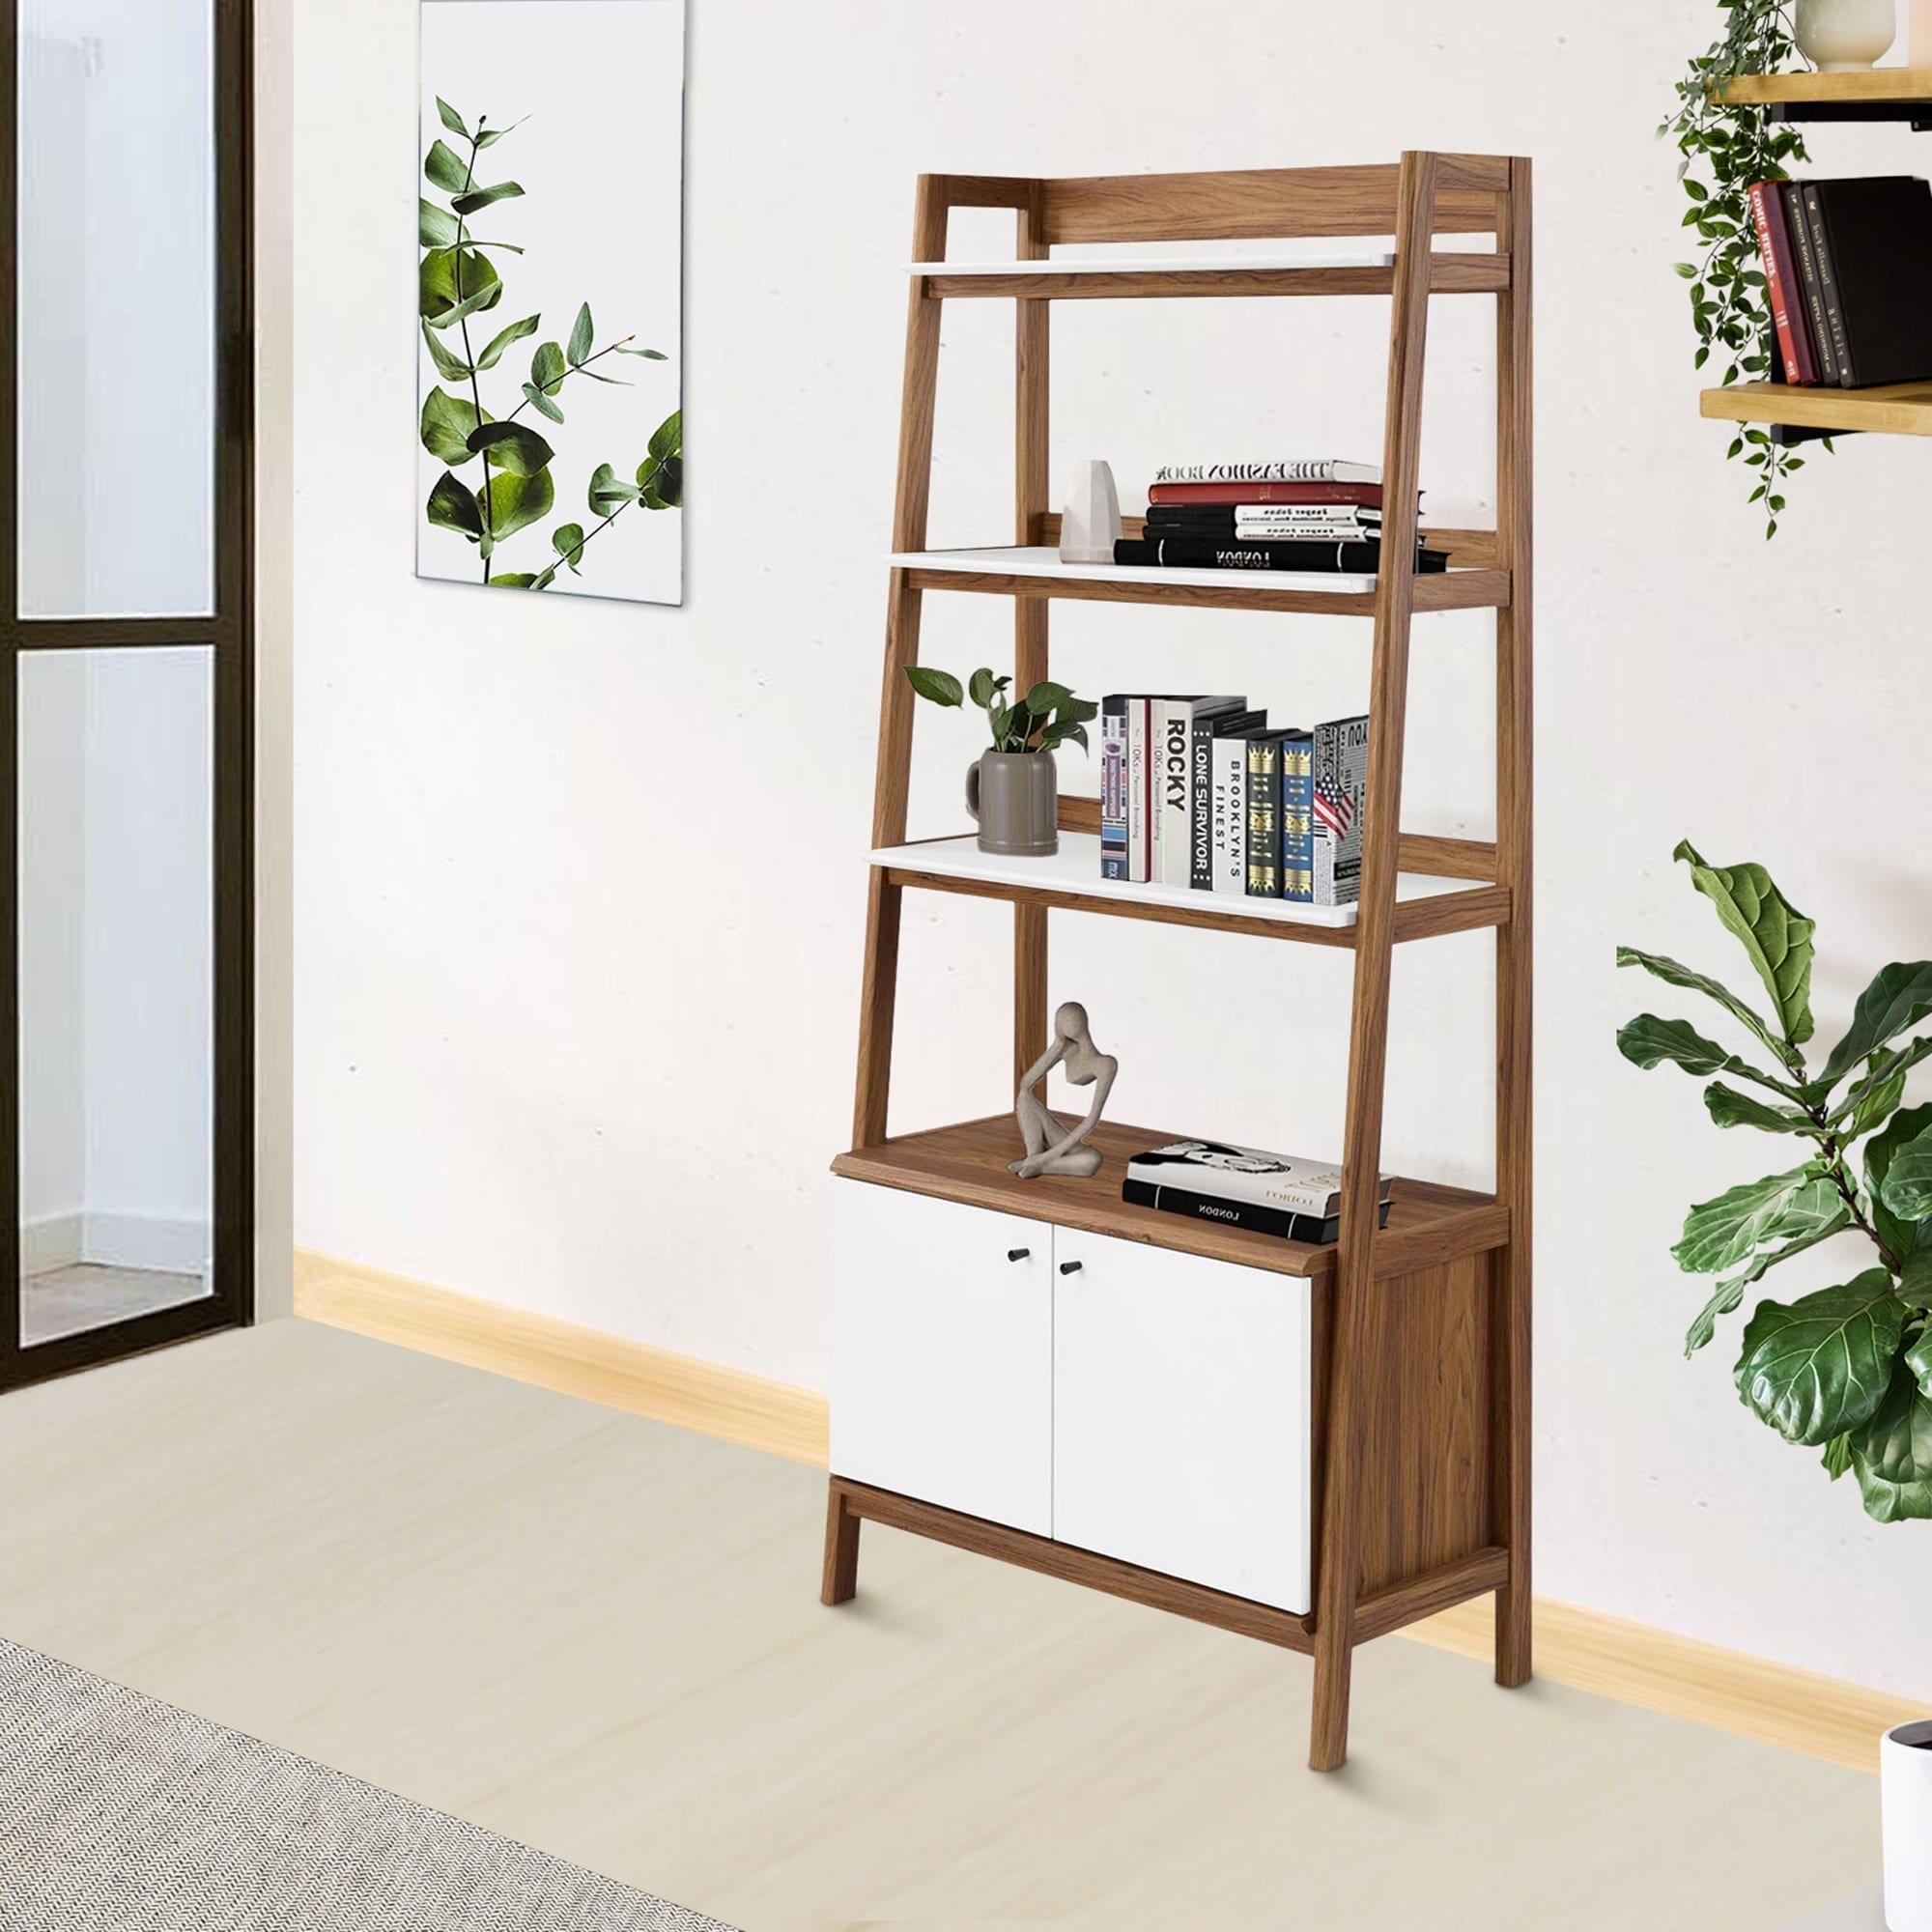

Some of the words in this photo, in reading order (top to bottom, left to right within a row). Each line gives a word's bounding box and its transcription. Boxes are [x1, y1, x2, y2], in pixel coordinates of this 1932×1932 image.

[1166, 719, 1186, 812] ROCKY
[1195, 745, 1208, 784] LONE
[1195, 787, 1208, 870] SURVIVOR
[1215, 785, 1225, 850] FINEST
[1230, 760, 1240, 877] BROOKLYN'S
